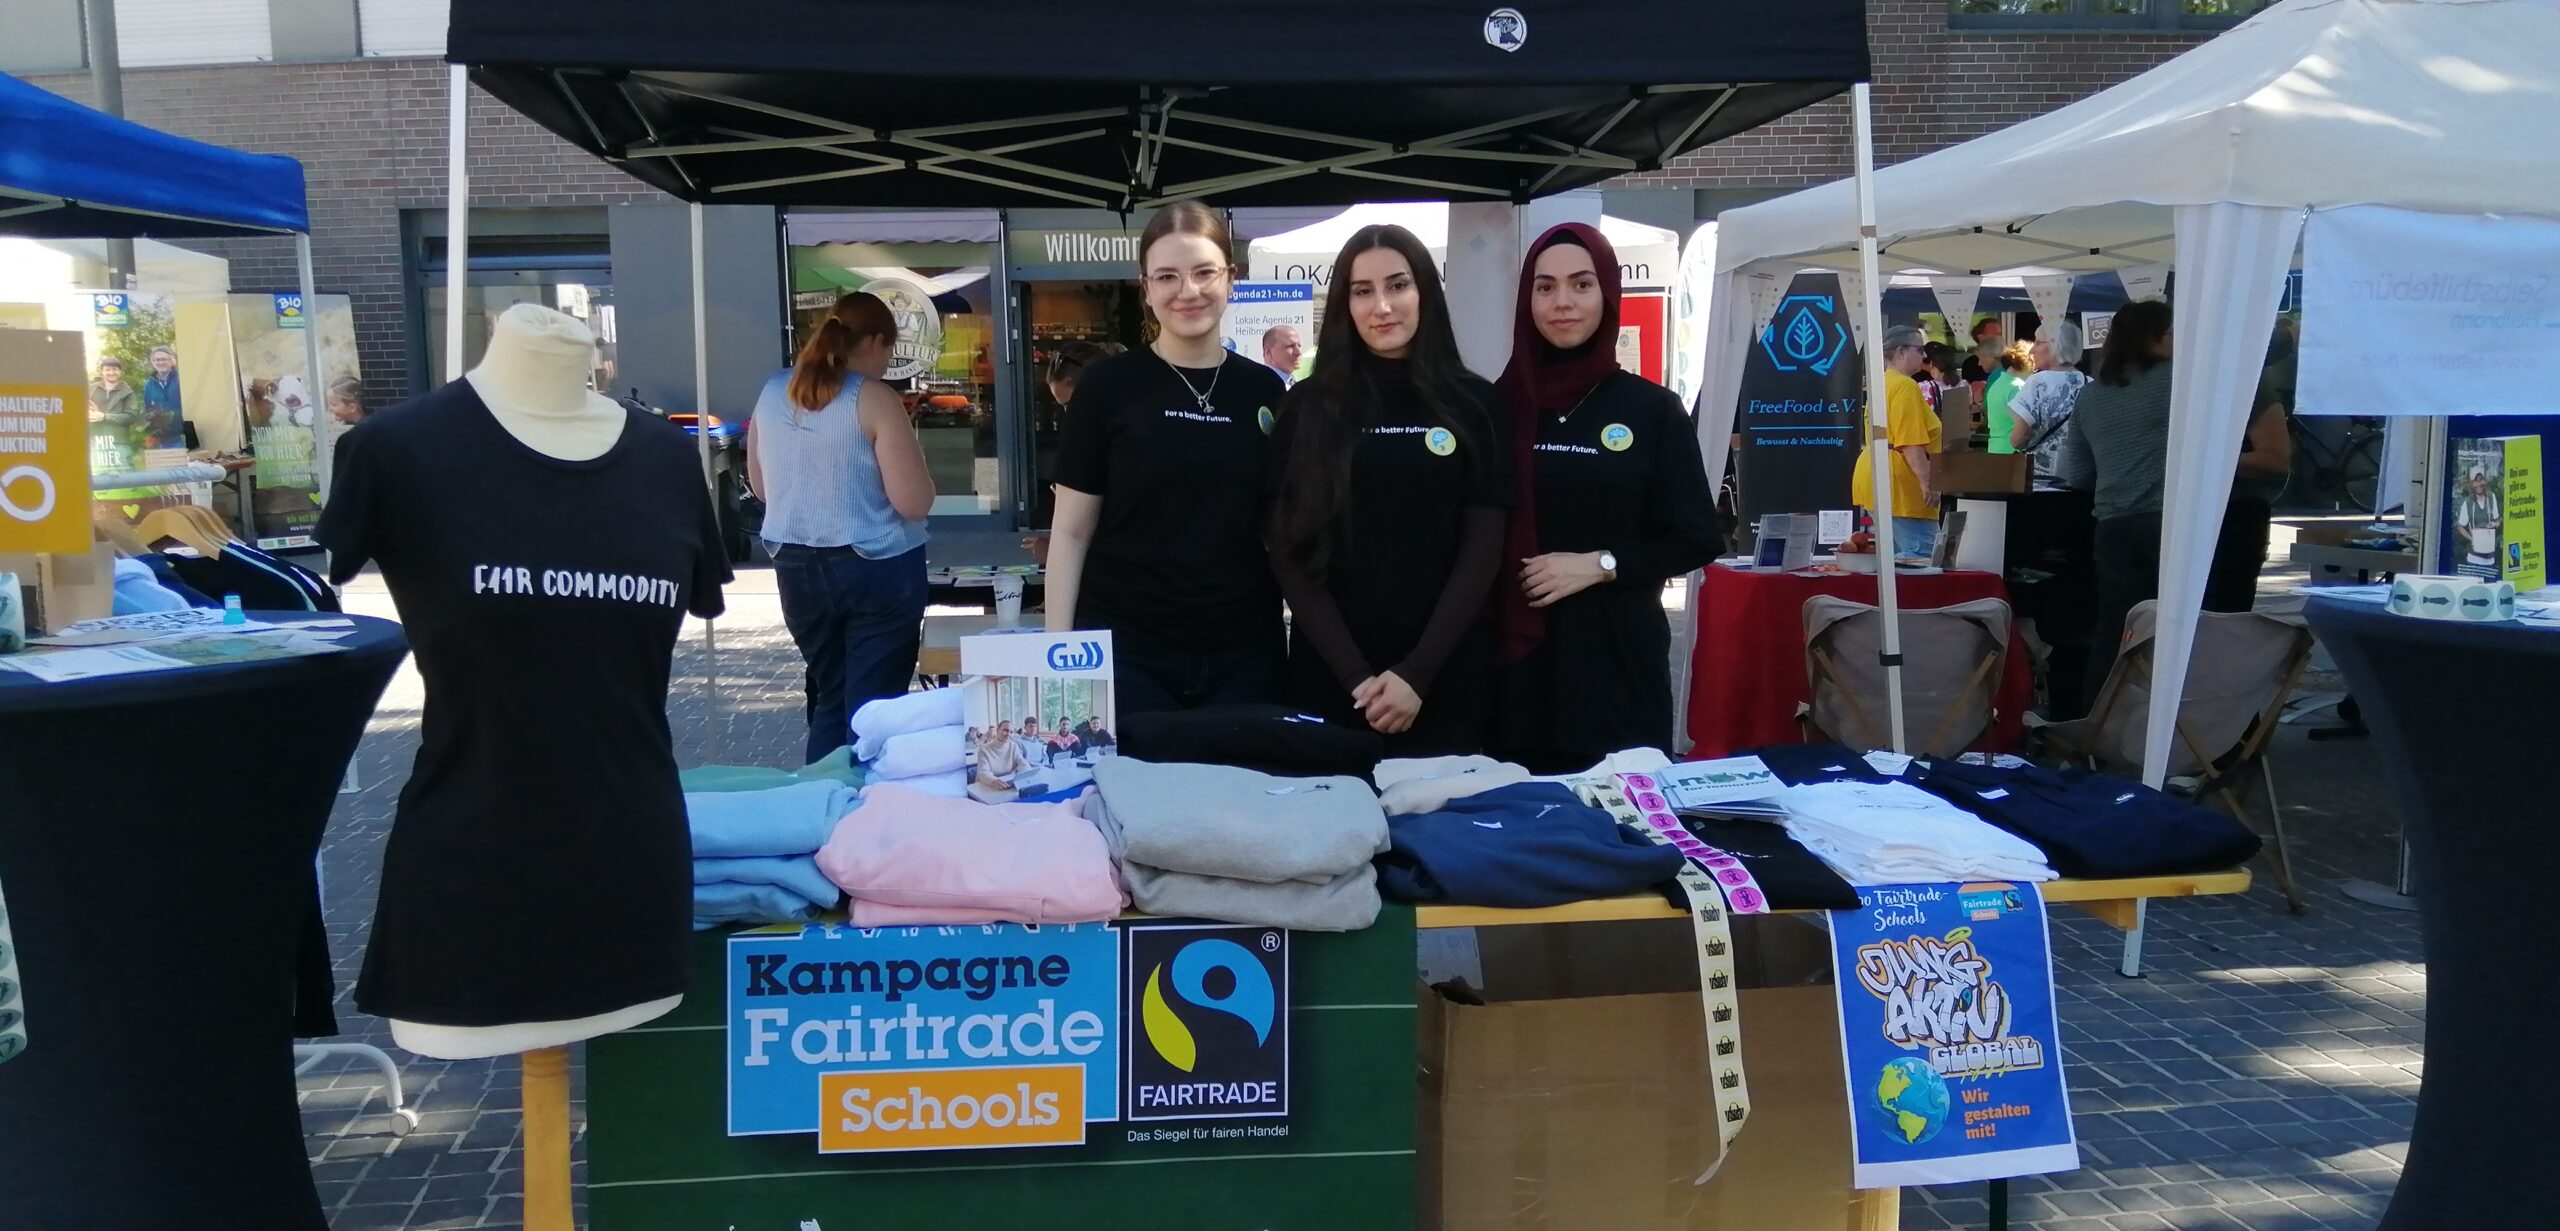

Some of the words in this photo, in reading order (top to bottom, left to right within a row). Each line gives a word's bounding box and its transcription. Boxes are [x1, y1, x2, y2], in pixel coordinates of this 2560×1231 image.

[277, 296, 302, 308] BIO
[1235, 315, 1260, 324] Lokale
[1262, 315, 1292, 326] Agenda
[1294, 315, 1304, 324] 21
[1748, 399, 1823, 414] FreeFood
[1184, 410, 1205, 421] better
[1206, 415, 1232, 423] Future.
[20, 417, 46, 433] UND
[1381, 426, 1404, 434] better
[95, 436, 116, 449] MIR
[1547, 443, 1570, 452] better
[1571, 445, 1599, 455] Future.
[1756, 437, 1789, 446] Bewusst
[1800, 436, 1844, 447] Nachhaltig
[97, 451, 123, 466] HIER
[543, 569, 679, 608] COMMODITY
[1707, 780, 1769, 789] tomorrow
[1873, 887, 1949, 909] Fairtrade-
[1963, 897, 2002, 908] Fairtrade
[1874, 908, 1927, 932] Schools
[1859, 939, 1985, 994] JUNG
[745, 953, 1070, 1002] Kampagne
[744, 999, 1104, 1067] Fairtrade
[1931, 1037, 2042, 1075] GLOBAL
[1140, 1082, 1277, 1107] FAIRTRADE
[1961, 1088, 1990, 1104] Wir
[842, 1083, 1060, 1133] Schools
[1964, 1103, 2031, 1125] gestalten
[1128, 1130, 1150, 1142] Das
[1154, 1128, 1190, 1142] Siegel
[1193, 1127, 1209, 1139] für
[1212, 1125, 1244, 1139] fairen
[1248, 1125, 1289, 1137] Handel
[1966, 1123, 1997, 1139] mit!
